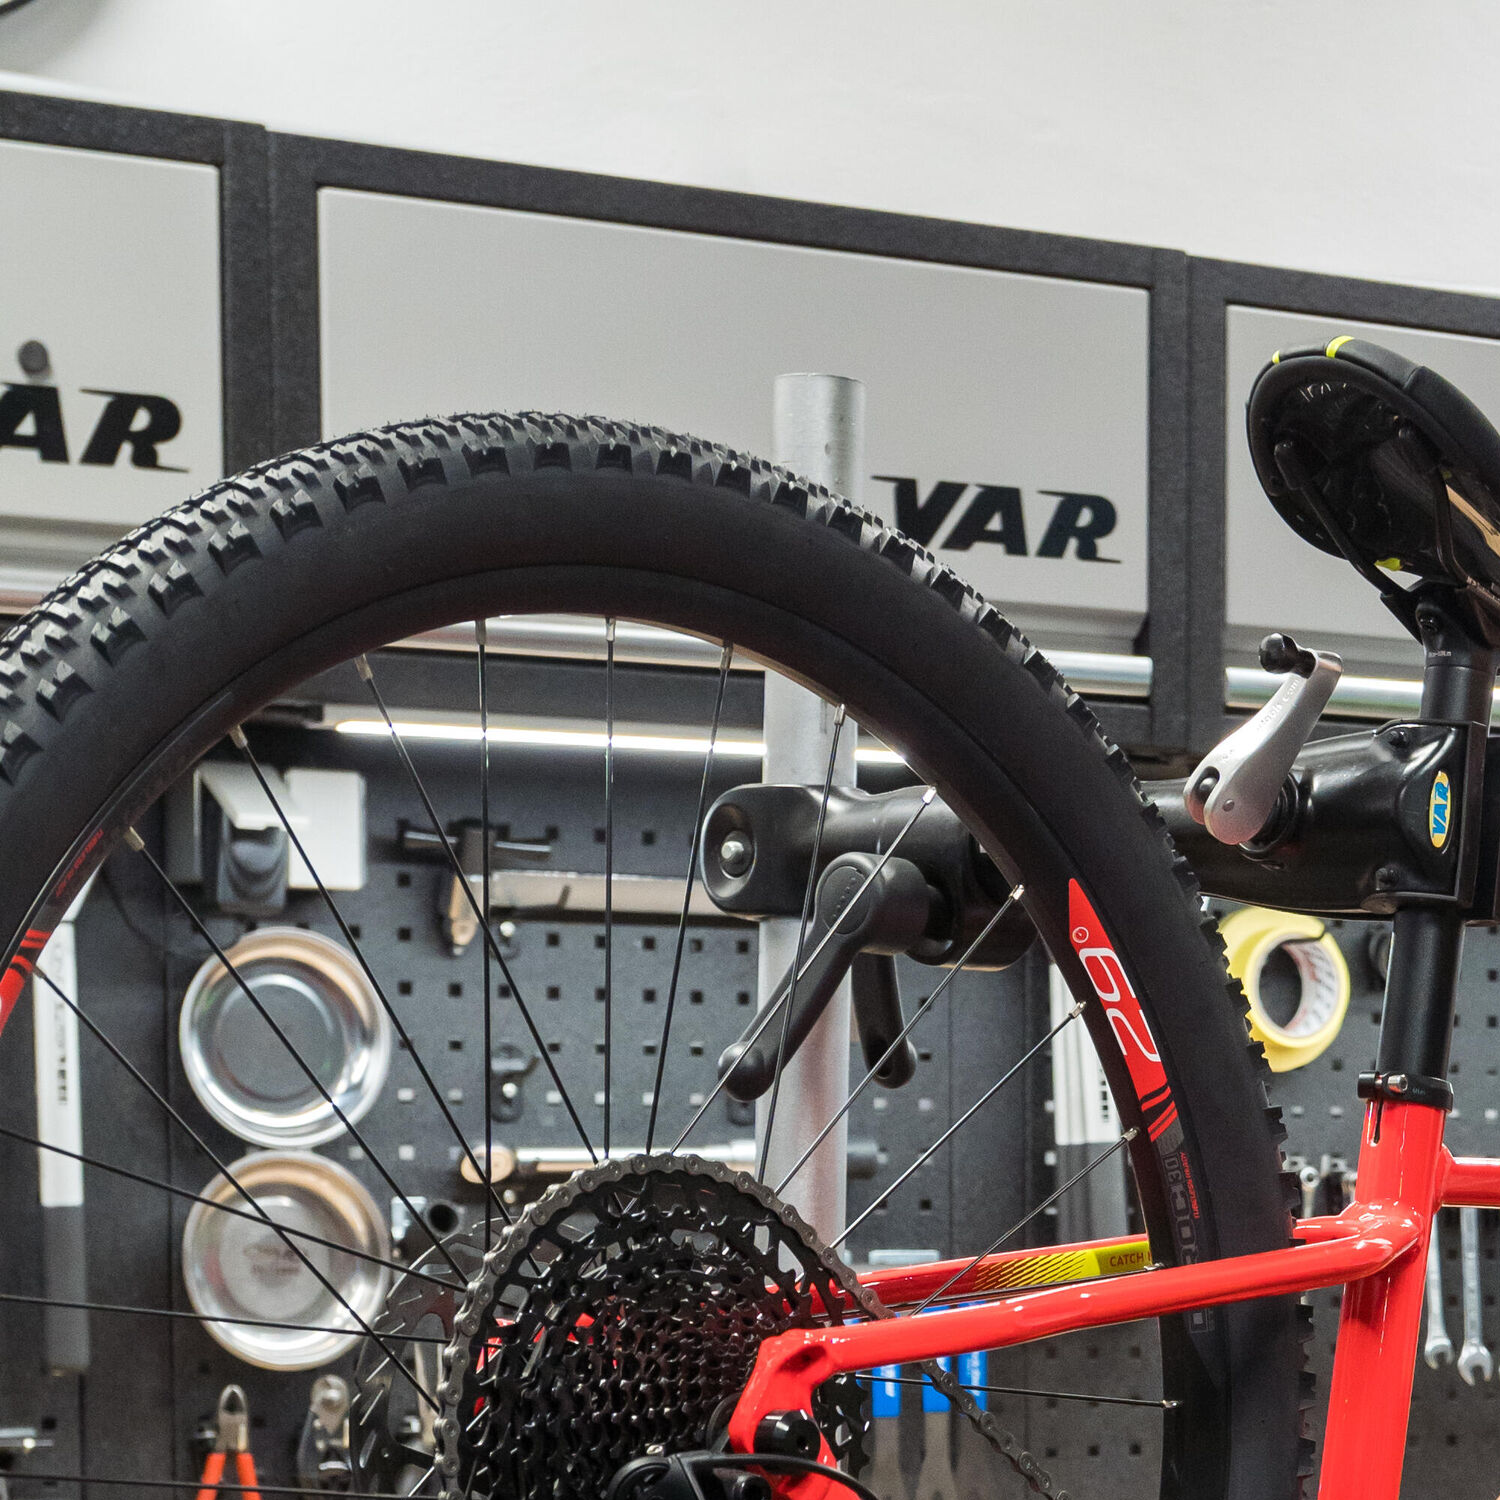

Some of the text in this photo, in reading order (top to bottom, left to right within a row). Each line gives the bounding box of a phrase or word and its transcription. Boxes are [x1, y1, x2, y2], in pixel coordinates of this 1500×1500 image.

[871, 475, 1122, 563] VAR
[1432, 781, 1450, 838] VAR
[1078, 947, 1162, 1062] 29
[1109, 1252, 1144, 1267] CATCH
